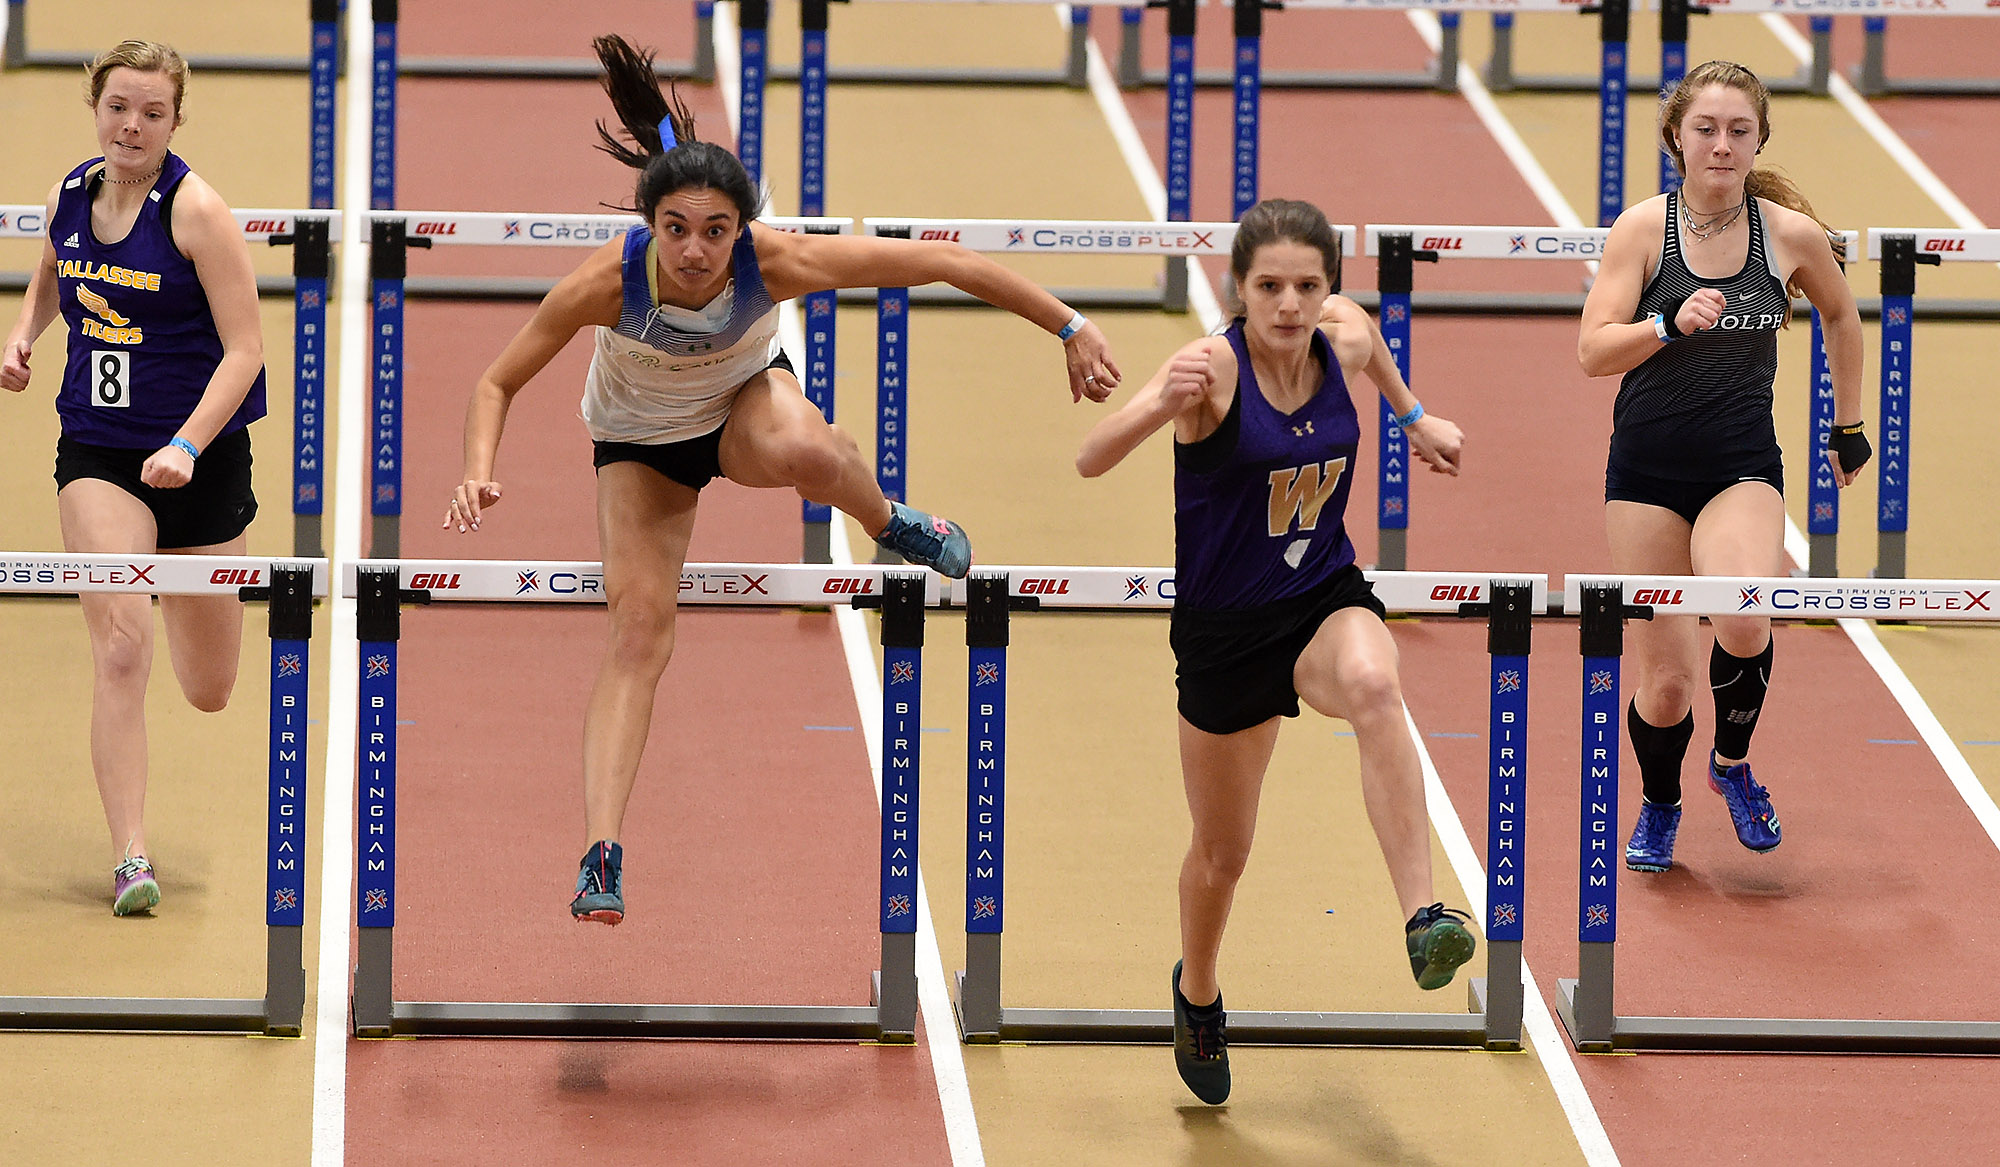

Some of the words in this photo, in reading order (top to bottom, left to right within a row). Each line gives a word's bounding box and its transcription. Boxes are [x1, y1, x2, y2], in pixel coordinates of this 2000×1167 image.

[245, 220, 286, 232] GILL
[415, 222, 457, 235] GILL
[920, 230, 960, 242] GILL
[1033, 230, 1213, 249] CROSSPLEX
[1421, 237, 1463, 250] GILL
[1924, 239, 1966, 251] GILL
[57, 260, 161, 291] TALLASSEE
[82, 318, 143, 344] TIGERS
[99, 354, 122, 404] 8
[301, 323, 317, 471] BIRMINGHAM
[378, 324, 395, 472] BIRMINGHAM
[882, 331, 899, 478] BIRMINGHAM
[1268, 456, 1347, 537] W
[210, 569, 261, 585] GILL
[410, 573, 460, 589] GILL
[823, 578, 873, 594] GILL
[1019, 579, 1069, 595] GILL
[1430, 585, 1481, 601] GILL
[1633, 589, 1683, 605] GILL
[1771, 589, 1991, 611] CROSSPLEX
[278, 695, 297, 871] BIRMINGHAM
[368, 696, 386, 872] BIRMINGHAM
[891, 702, 910, 878] BIRMINGHAM
[976, 704, 995, 880] BIRMINGHAM
[1497, 711, 1516, 886] BIRMINGHAM
[1589, 712, 1608, 887] BIRMINGHAM
